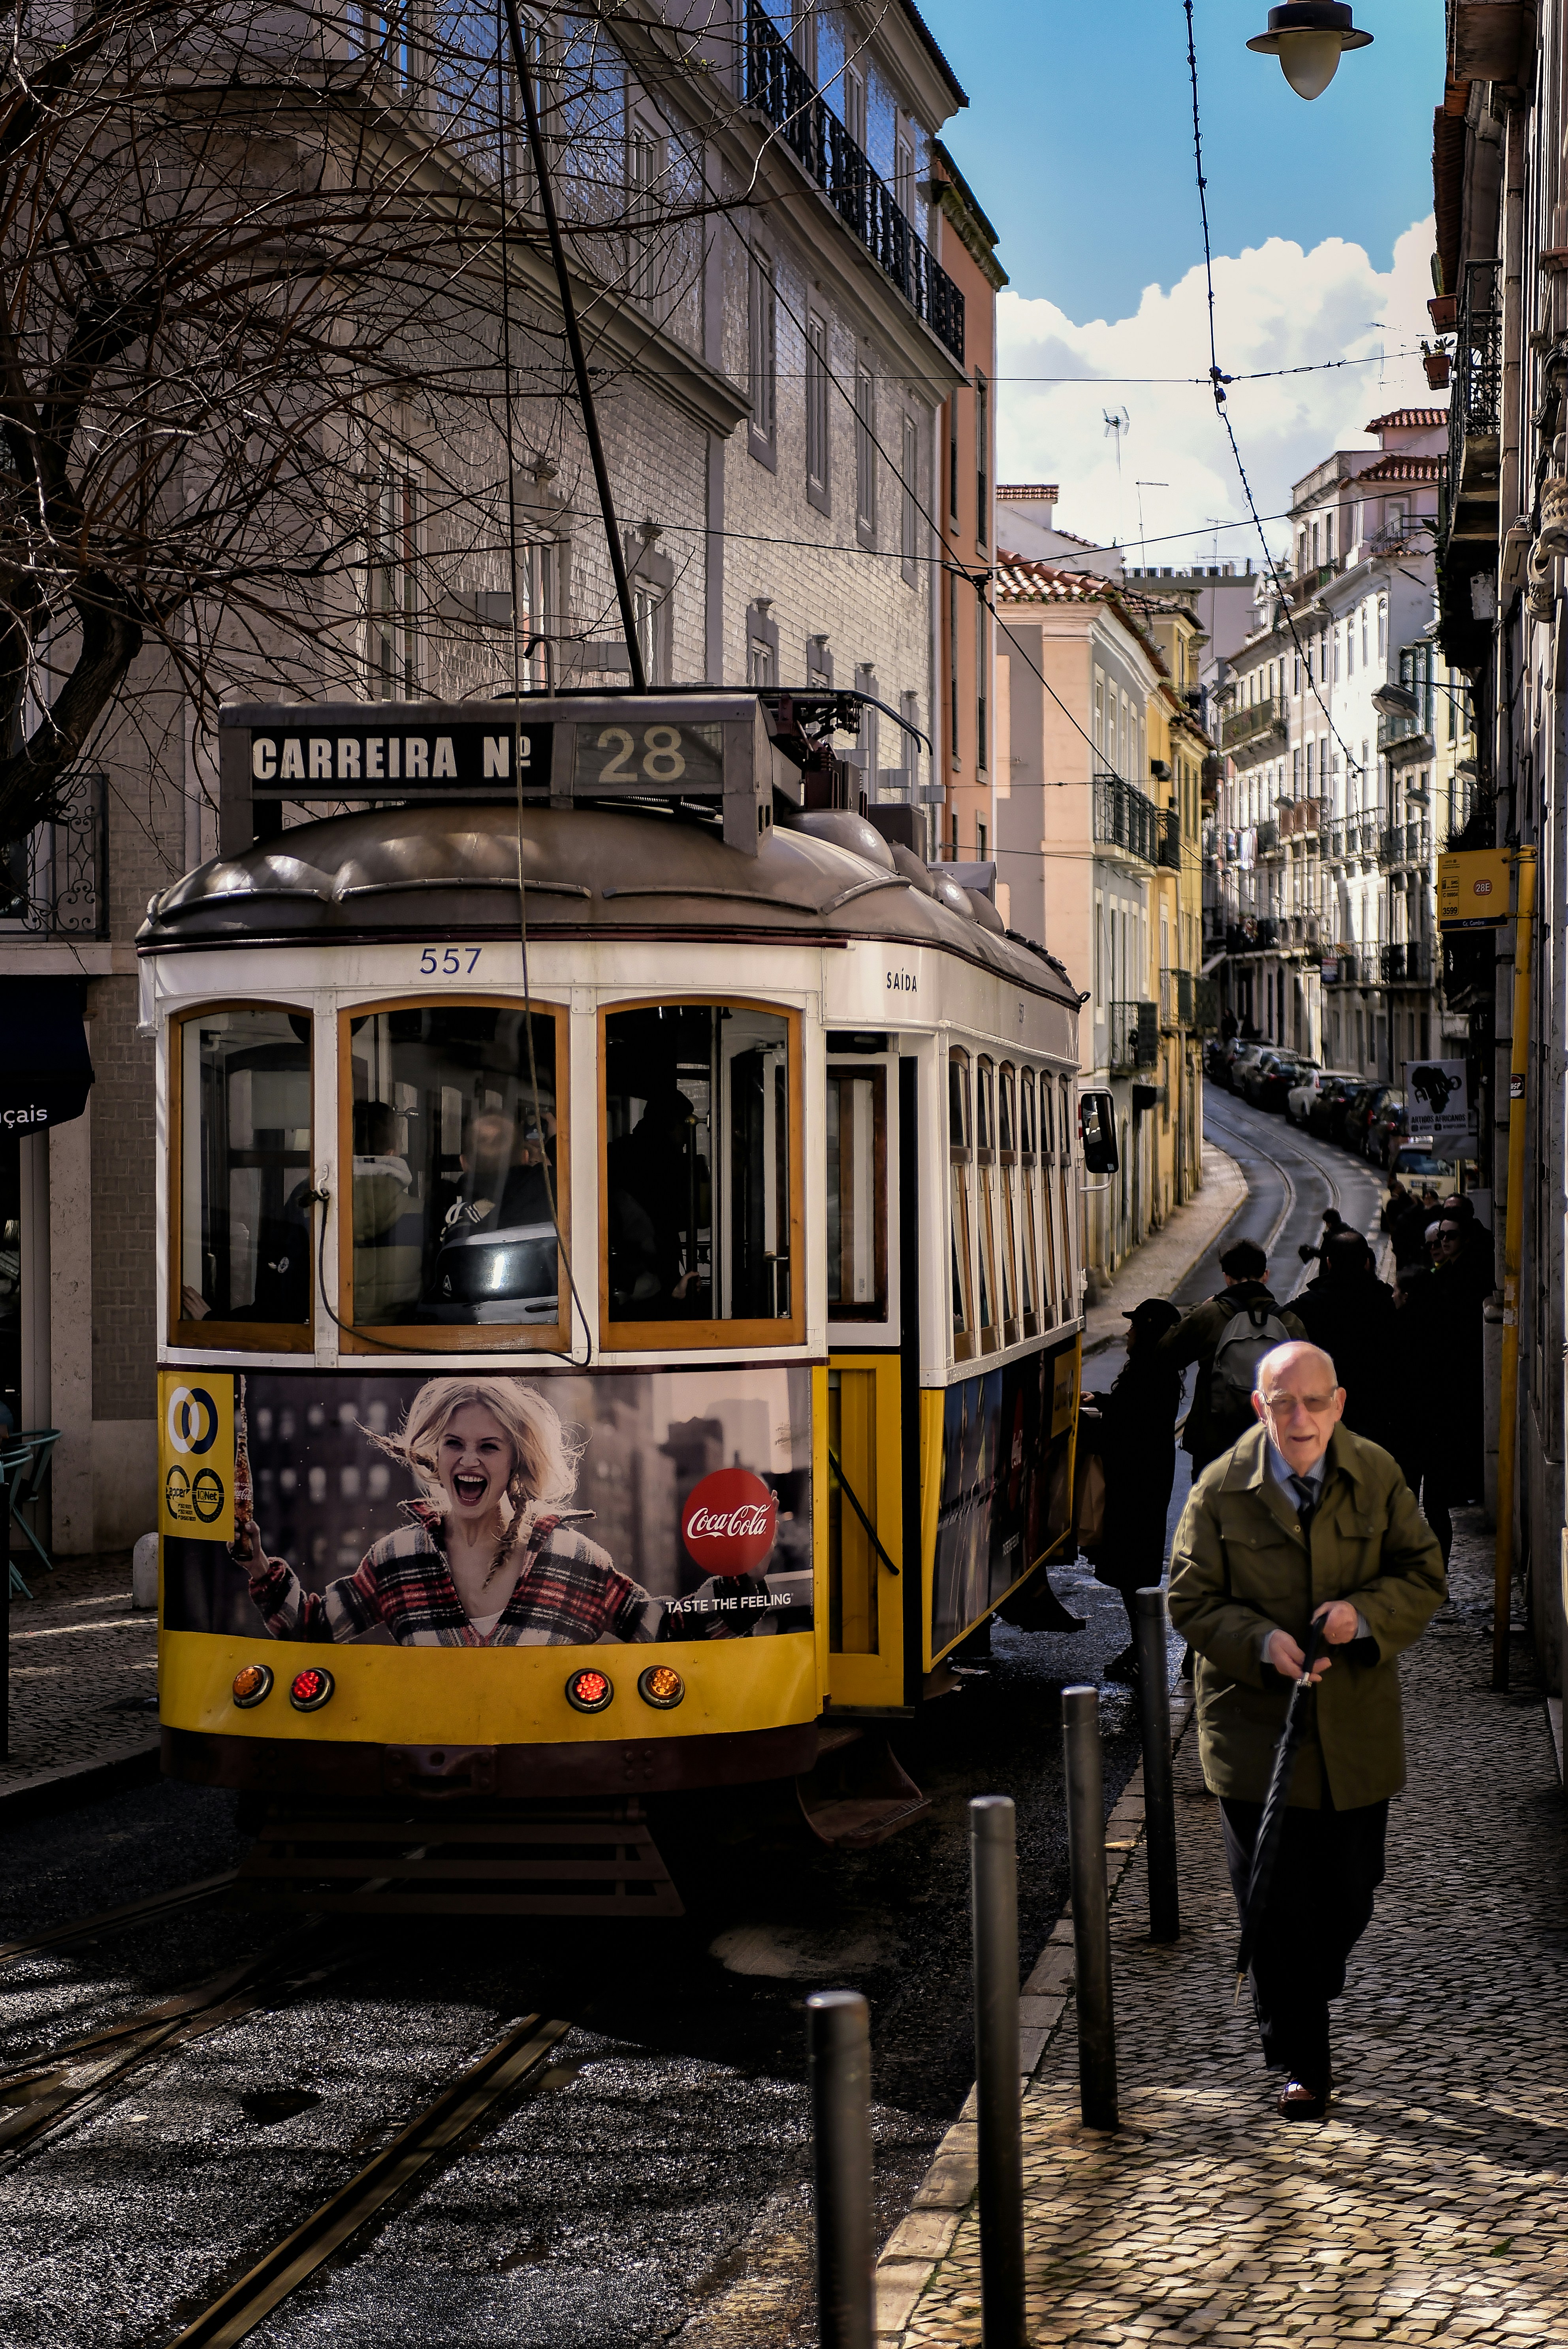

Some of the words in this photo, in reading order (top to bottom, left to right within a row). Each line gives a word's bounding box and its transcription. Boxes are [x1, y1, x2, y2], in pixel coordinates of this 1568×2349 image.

[253, 737, 457, 779] CARREIRA
[597, 725, 686, 782] 28
[1476, 883, 1491, 893] 28E
[420, 948, 483, 974] 557
[887, 966, 917, 992] SAÍDA
[0, 1104, 47, 1129] çais
[1434, 1113, 1466, 1123] AFRICANOS
[687, 1503, 772, 1539] Coca-Cola
[666, 1599, 708, 1613] TASTE
[712, 1597, 738, 1610] THE
